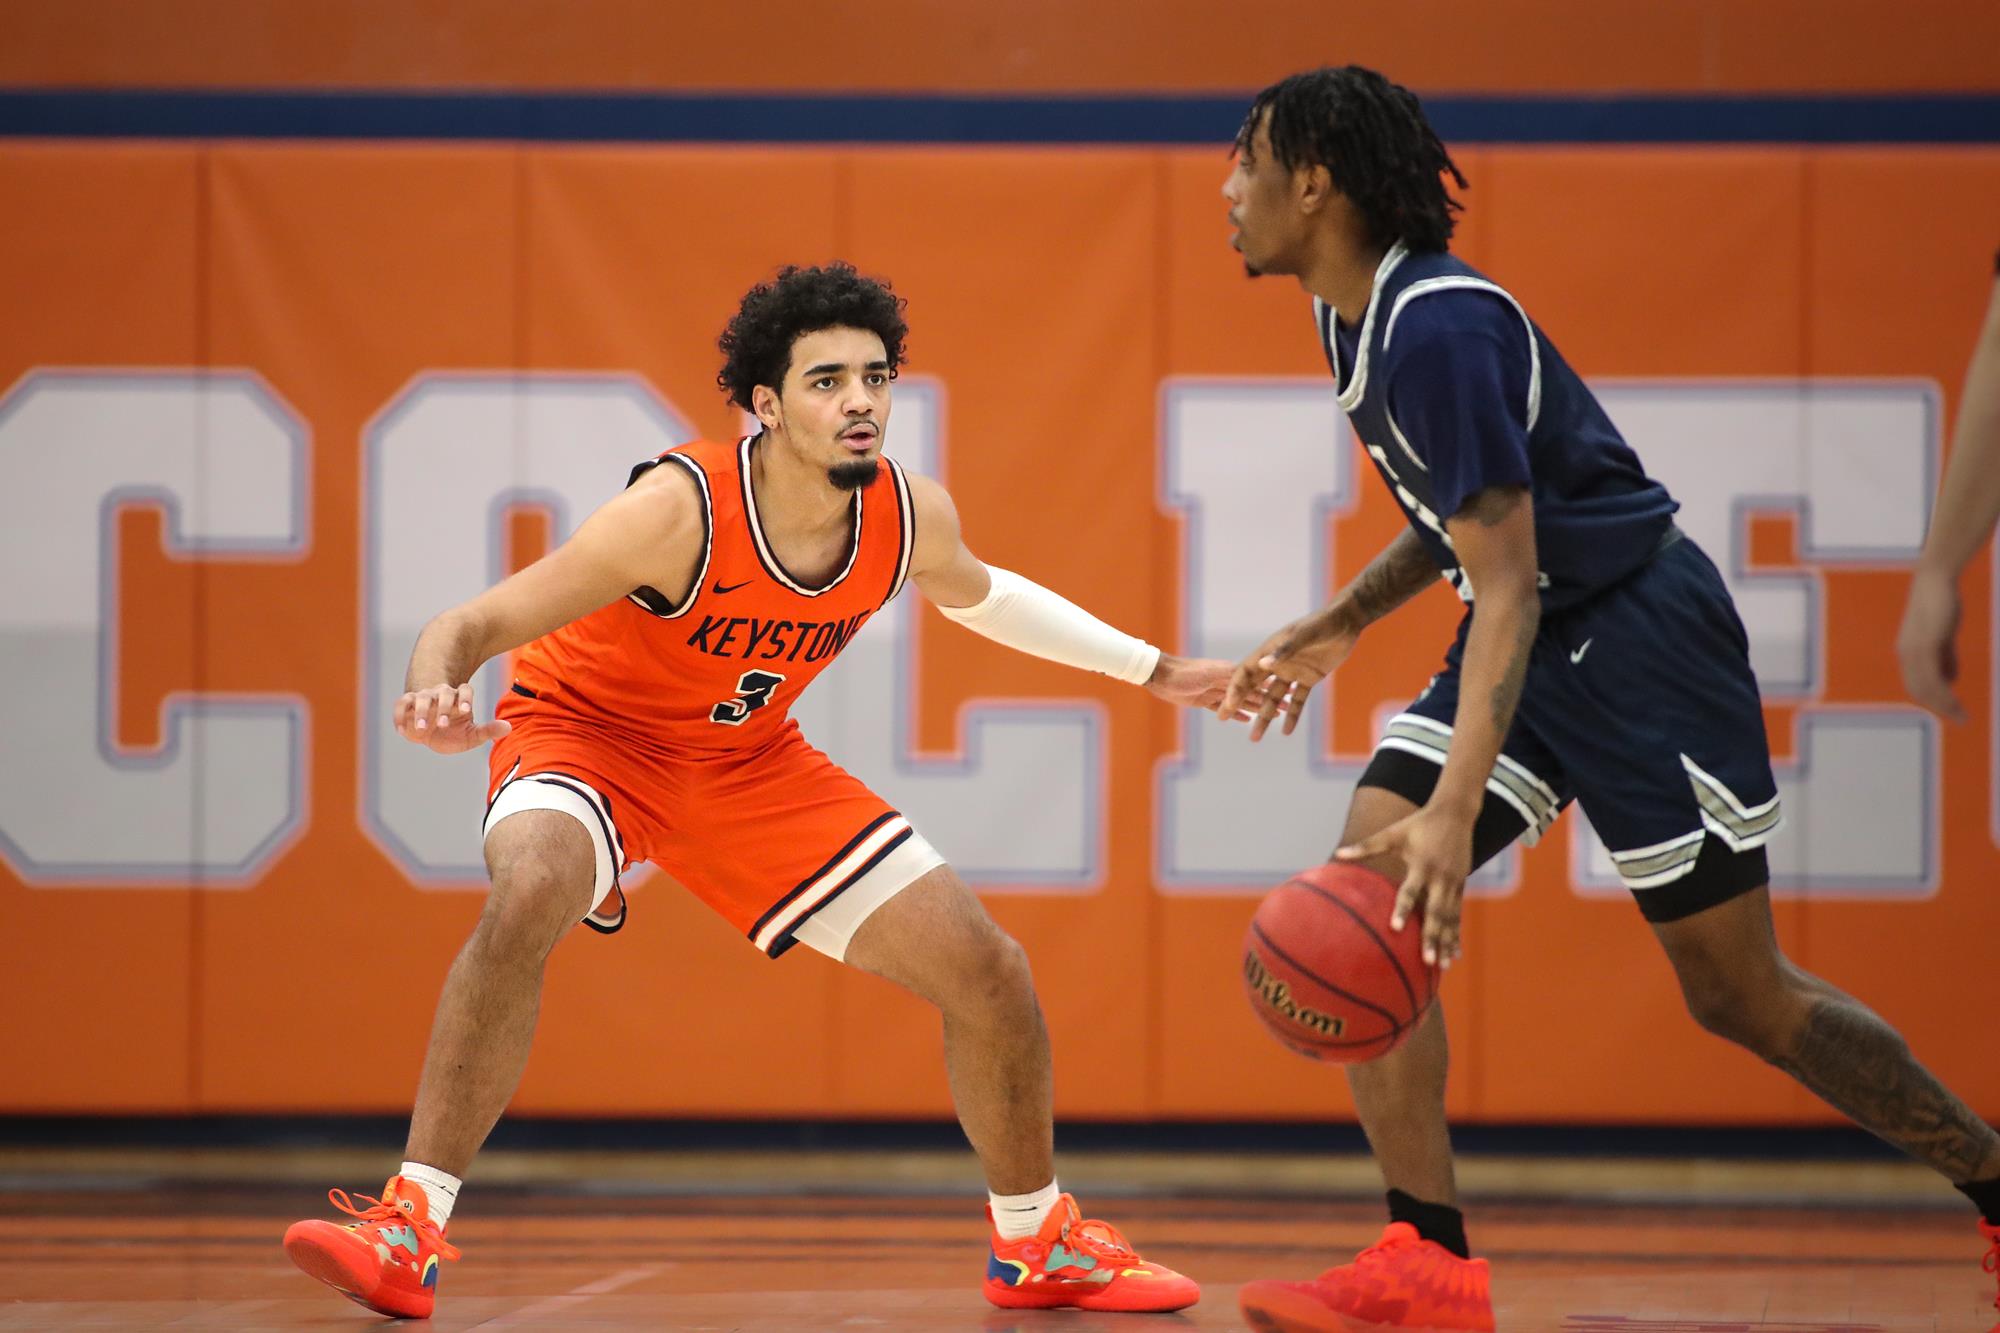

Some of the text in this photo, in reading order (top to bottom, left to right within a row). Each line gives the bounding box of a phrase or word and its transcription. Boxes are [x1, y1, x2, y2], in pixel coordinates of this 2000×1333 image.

[0, 367, 2000, 898] COLLE
[709, 668, 786, 726] 3
[1245, 950, 1344, 1036] Wilson
